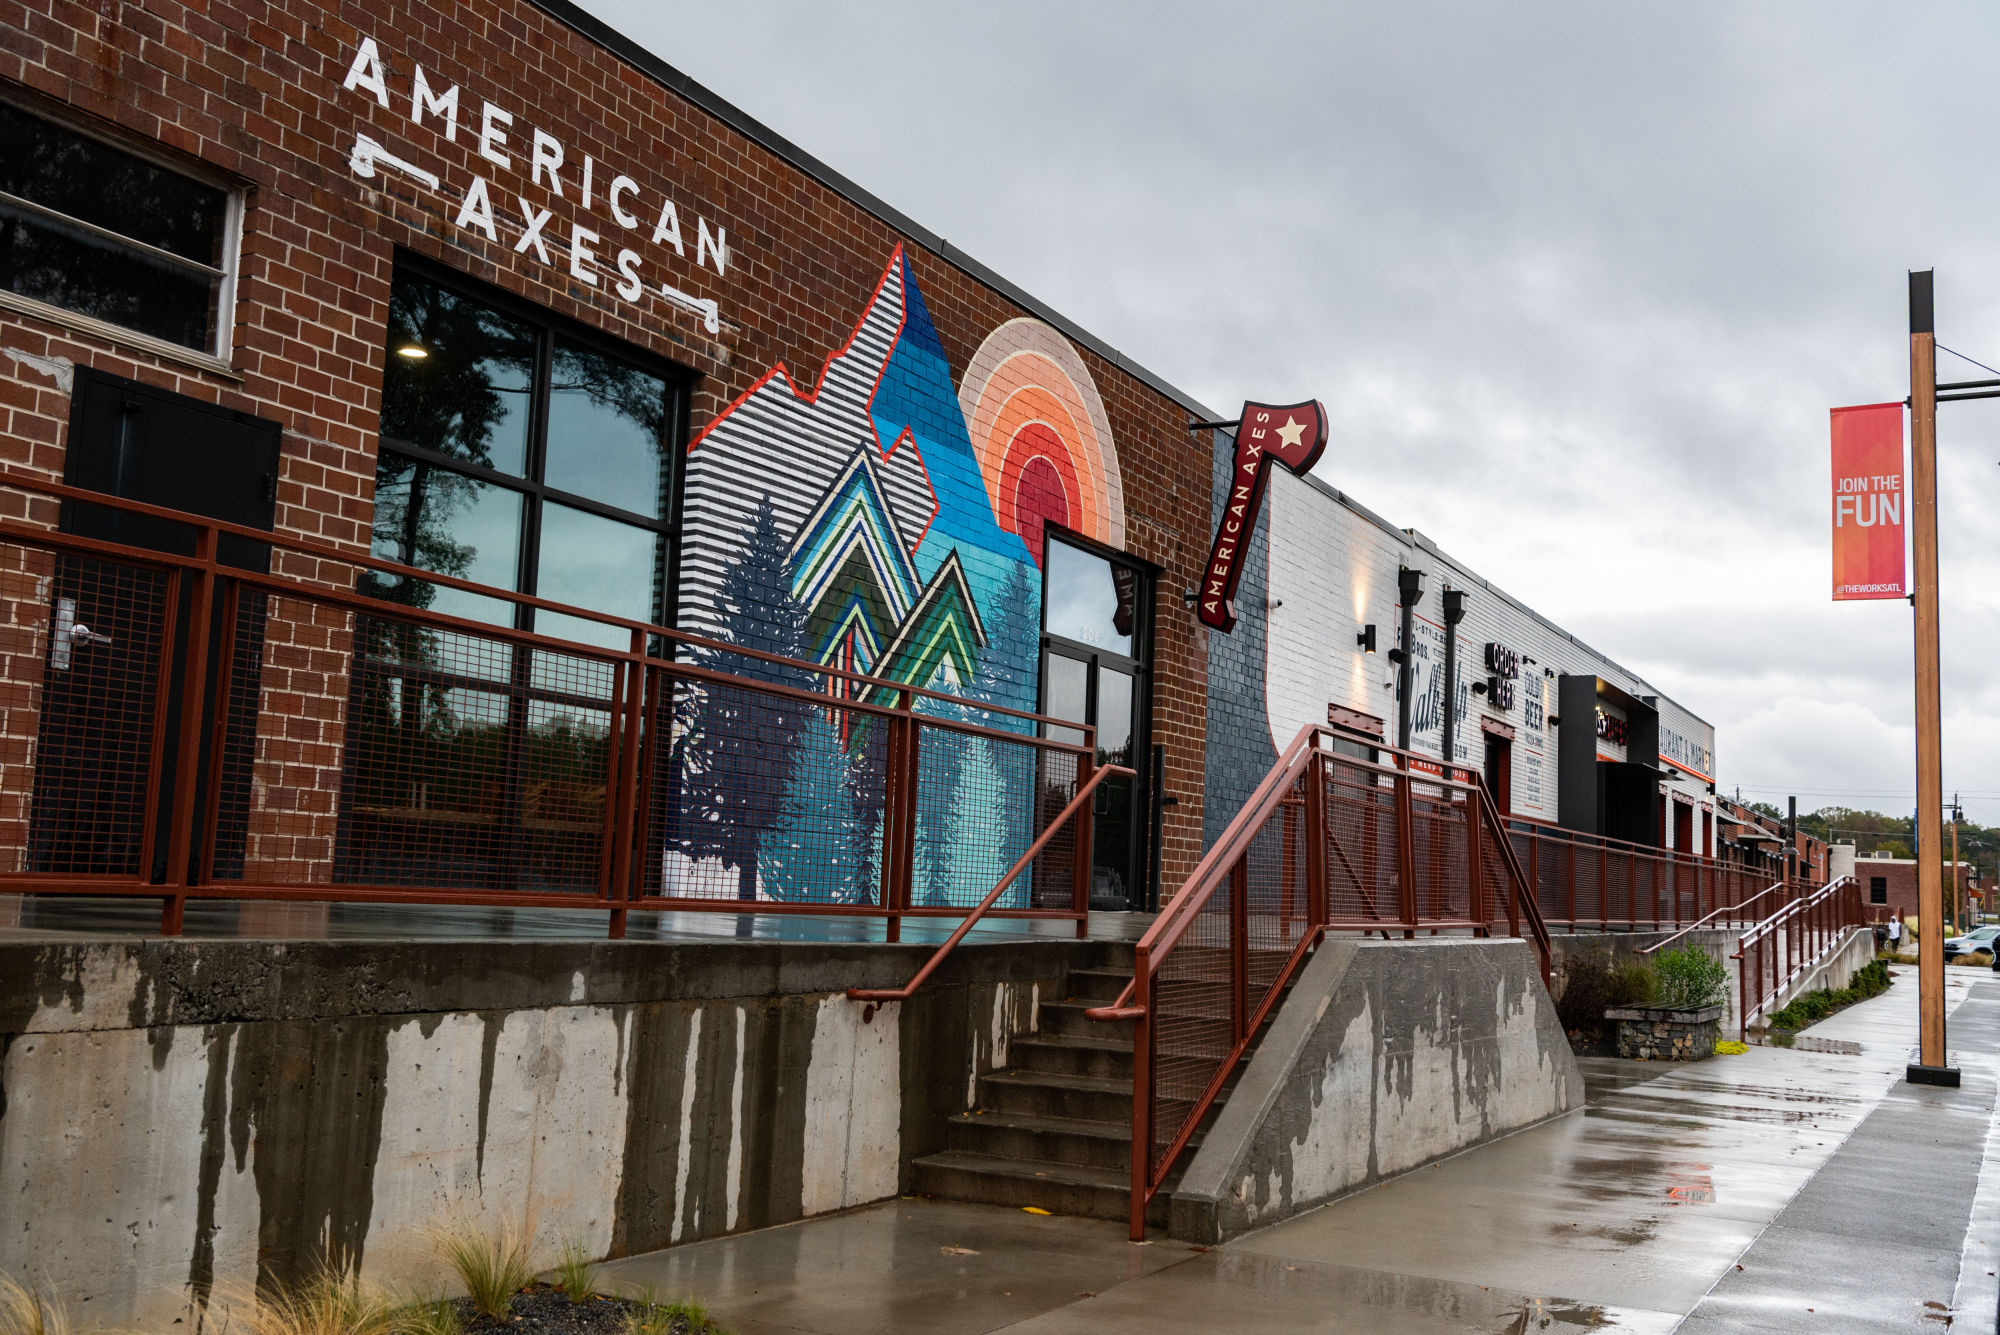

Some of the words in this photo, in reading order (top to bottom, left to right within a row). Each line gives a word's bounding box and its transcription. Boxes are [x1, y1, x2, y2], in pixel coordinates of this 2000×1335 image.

[343, 37, 725, 276] AMERICAN
[455, 175, 642, 302] AXES
[1836, 477, 1868, 493] JOIN
[1871, 475, 1900, 491] THE
[1204, 485, 1250, 613] AMERICAN
[1242, 411, 1270, 475] AXES
[1836, 492, 1900, 528] FUN
[1836, 583, 1902, 594] @THEWORKSATL
[1493, 643, 1519, 679] ORDER
[1496, 677, 1516, 711] HERE
[1525, 698, 1543, 732] BEER
